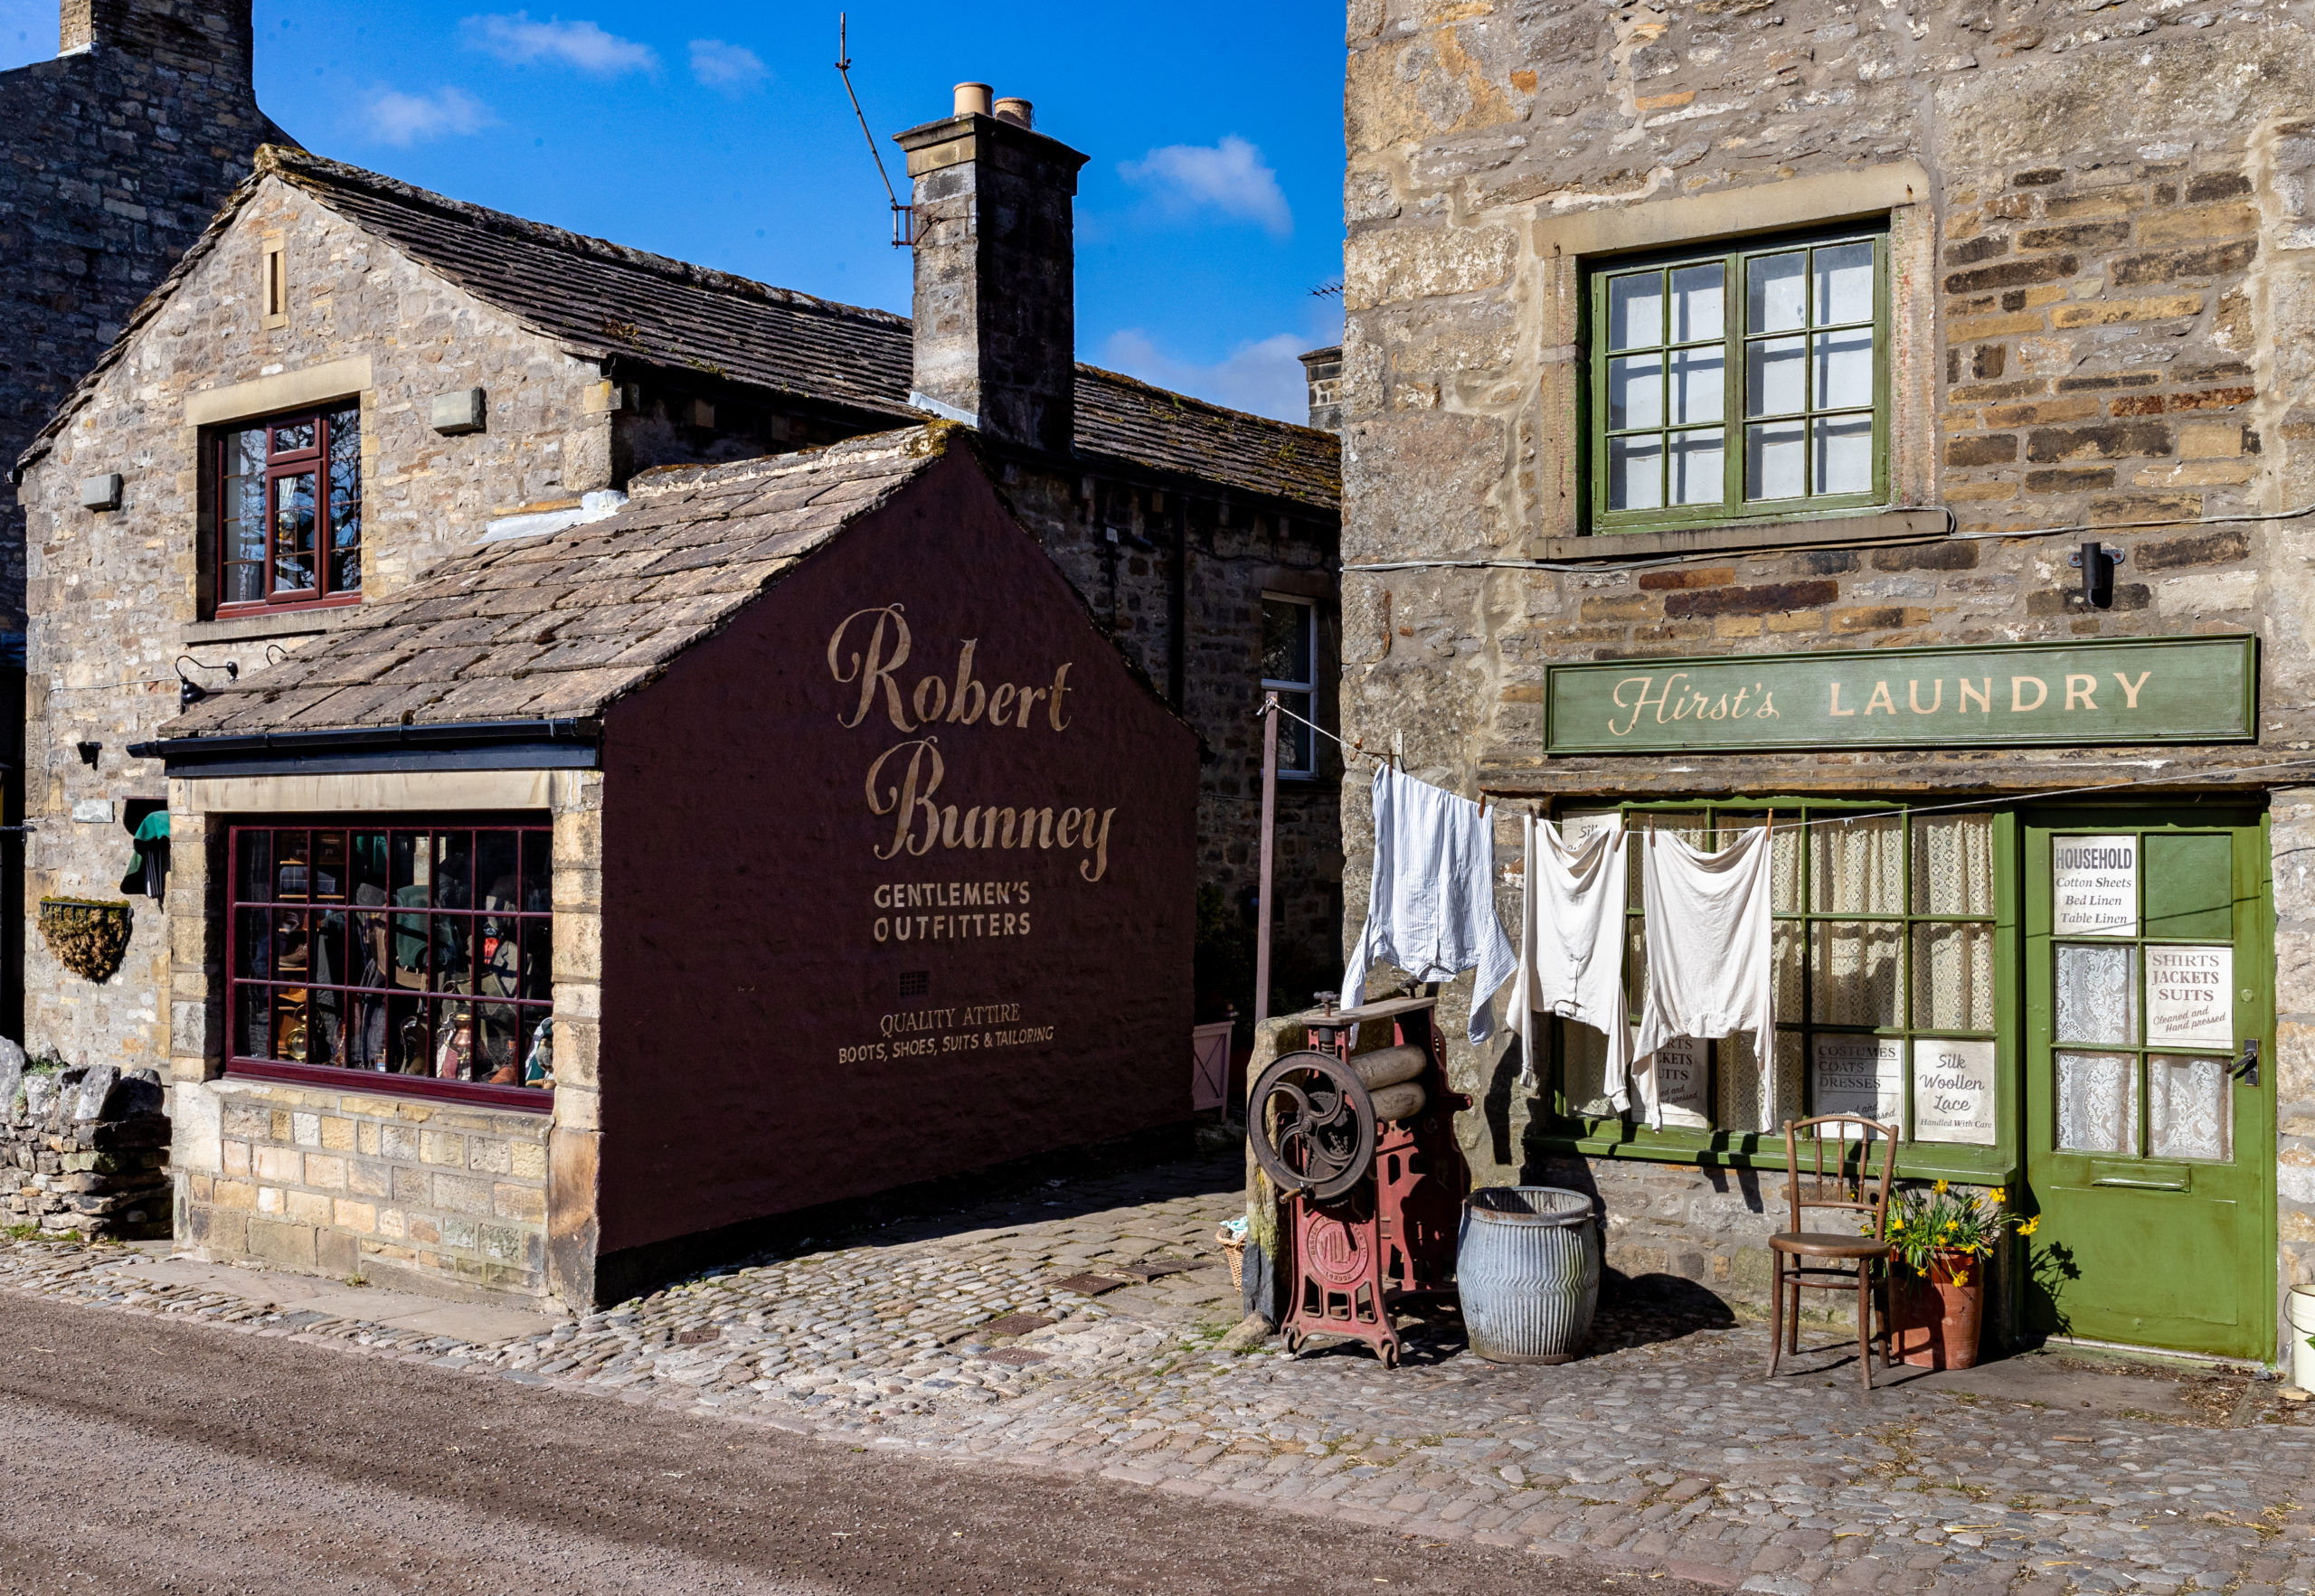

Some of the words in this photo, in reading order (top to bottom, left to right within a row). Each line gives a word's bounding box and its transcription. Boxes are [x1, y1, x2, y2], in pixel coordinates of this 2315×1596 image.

[827, 602, 1072, 733] Robert
[1608, 673, 1781, 736] Hirst's
[1829, 671, 2152, 716] LAUNDRY
[865, 735, 1117, 883] Bunney
[2055, 847, 2132, 870] HOUSEHOLD
[2055, 877, 2093, 888] Cotton
[2095, 876, 2132, 888] Sheets
[874, 881, 1031, 909] GENTLEMEN'S
[2065, 894, 2087, 905] Bed
[2089, 894, 2122, 906] Linen
[2061, 912, 2093, 923] Table
[2094, 912, 2128, 924] Linen
[874, 911, 1031, 942] OUTFITTERS
[2152, 954, 2220, 967] SHIRTS
[2151, 970, 2220, 986] JACKETS
[2159, 988, 2215, 1002] SUITS
[880, 1007, 956, 1039] QUALITY
[962, 1003, 1022, 1026] ATTIRE
[2153, 1009, 2189, 1025] Cleaned
[2191, 1005, 2210, 1017] and
[2165, 1019, 2190, 1033] Hand
[2190, 1011, 2227, 1030] pressed
[838, 1043, 888, 1064] BOOTS,
[892, 1037, 938, 1056] SHOES,
[942, 1034, 979, 1052] SUITS
[984, 1032, 994, 1048] &
[996, 1025, 1055, 1046] TAILORING
[1667, 1038, 1693, 1050] RTS
[1818, 1045, 1896, 1058] COSTUMES
[1657, 1052, 1693, 1066] CKETS
[1819, 1061, 1865, 1072] COATS
[1936, 1053, 1967, 1069] Silk
[1658, 1069, 1689, 1081] UITS
[1819, 1077, 1881, 1089] DRESSES
[1919, 1074, 1985, 1091] Woollen
[1933, 1095, 1971, 1114] Lace
[1921, 1119, 1952, 1127] Handled
[1954, 1119, 1973, 1128] With
[1974, 1120, 1992, 1129] Care
